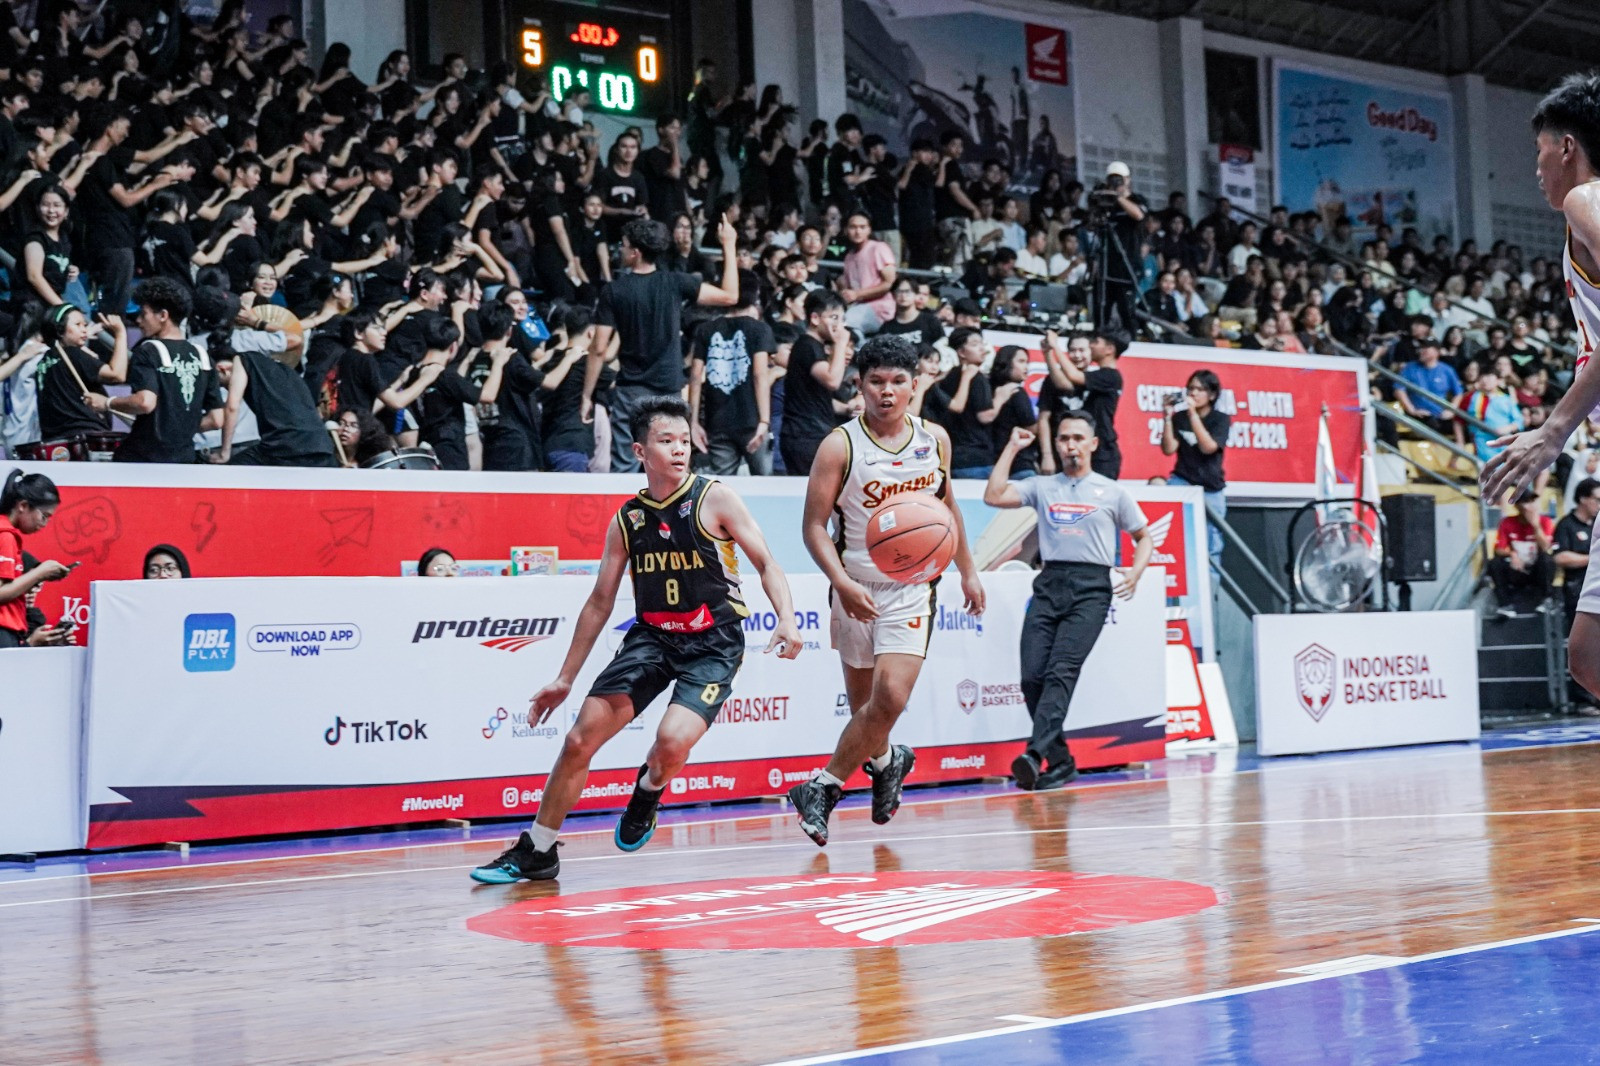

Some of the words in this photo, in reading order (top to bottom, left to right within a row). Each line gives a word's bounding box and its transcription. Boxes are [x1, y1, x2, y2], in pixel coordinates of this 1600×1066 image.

[523, 30, 541, 66] 5
[639, 47, 657, 81] 0
[1247, 390, 1295, 418] NORTH
[1251, 421, 1288, 450] 2024
[635, 550, 705, 574] LOYOLA
[665, 578, 680, 606] 8
[411, 616, 560, 644] proteam
[744, 610, 820, 631] MOOR
[189, 628, 231, 650] DBL
[256, 630, 327, 644] DOWNLOAD
[329, 629, 354, 642] APP
[187, 648, 228, 661] PLAY
[290, 645, 321, 657] NOW
[1343, 654, 1431, 678] INDONESIA
[700, 683, 720, 706] 8
[981, 683, 1021, 695] INDONES
[1344, 678, 1448, 705] BASKETBALL
[981, 695, 1028, 708] BASKETBA
[351, 718, 429, 744] TikTok
[511, 725, 559, 740] Keluarga
[940, 754, 986, 770] #MoveUp!
[688, 776, 711, 790] DBL
[712, 775, 736, 791] Play
[401, 793, 464, 812] #MoveUp!
